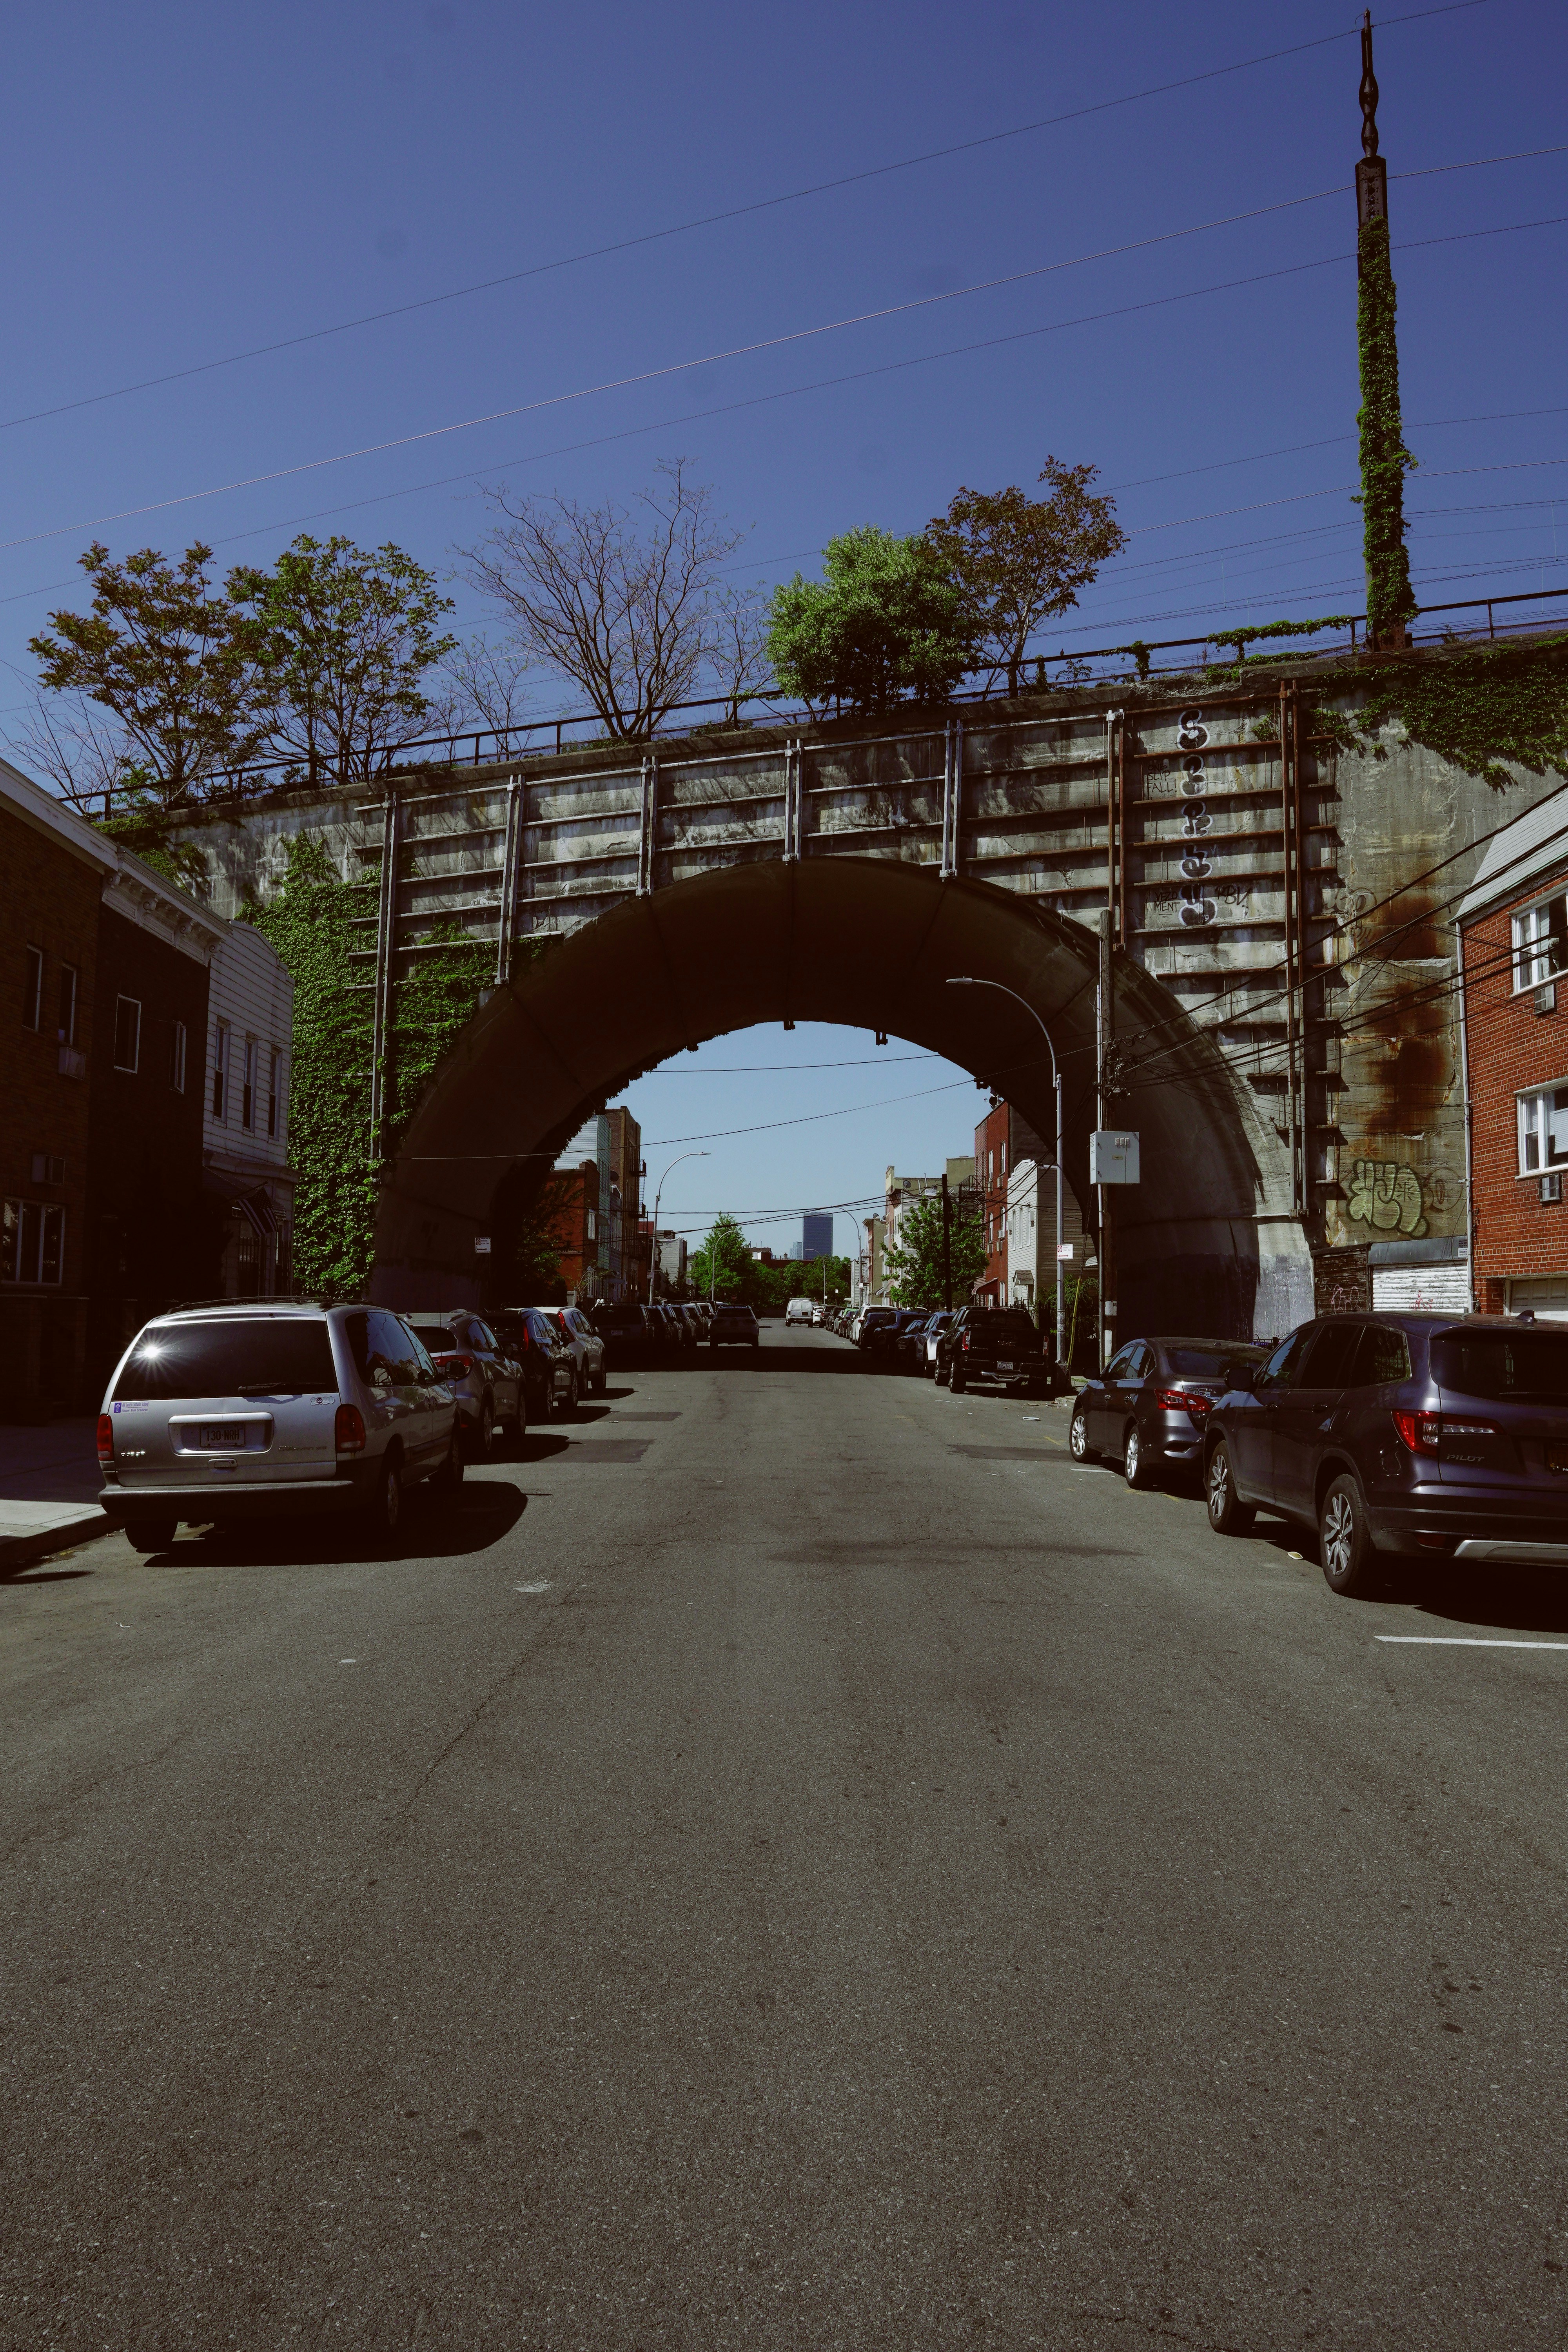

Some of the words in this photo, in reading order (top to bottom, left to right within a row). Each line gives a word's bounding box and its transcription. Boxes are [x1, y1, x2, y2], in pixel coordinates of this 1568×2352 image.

[1148, 763, 1168, 772] ONE
[1147, 770, 1170, 780] SLIP
[1147, 779, 1177, 793] FALL!
[1154, 901, 1180, 912] MENT
